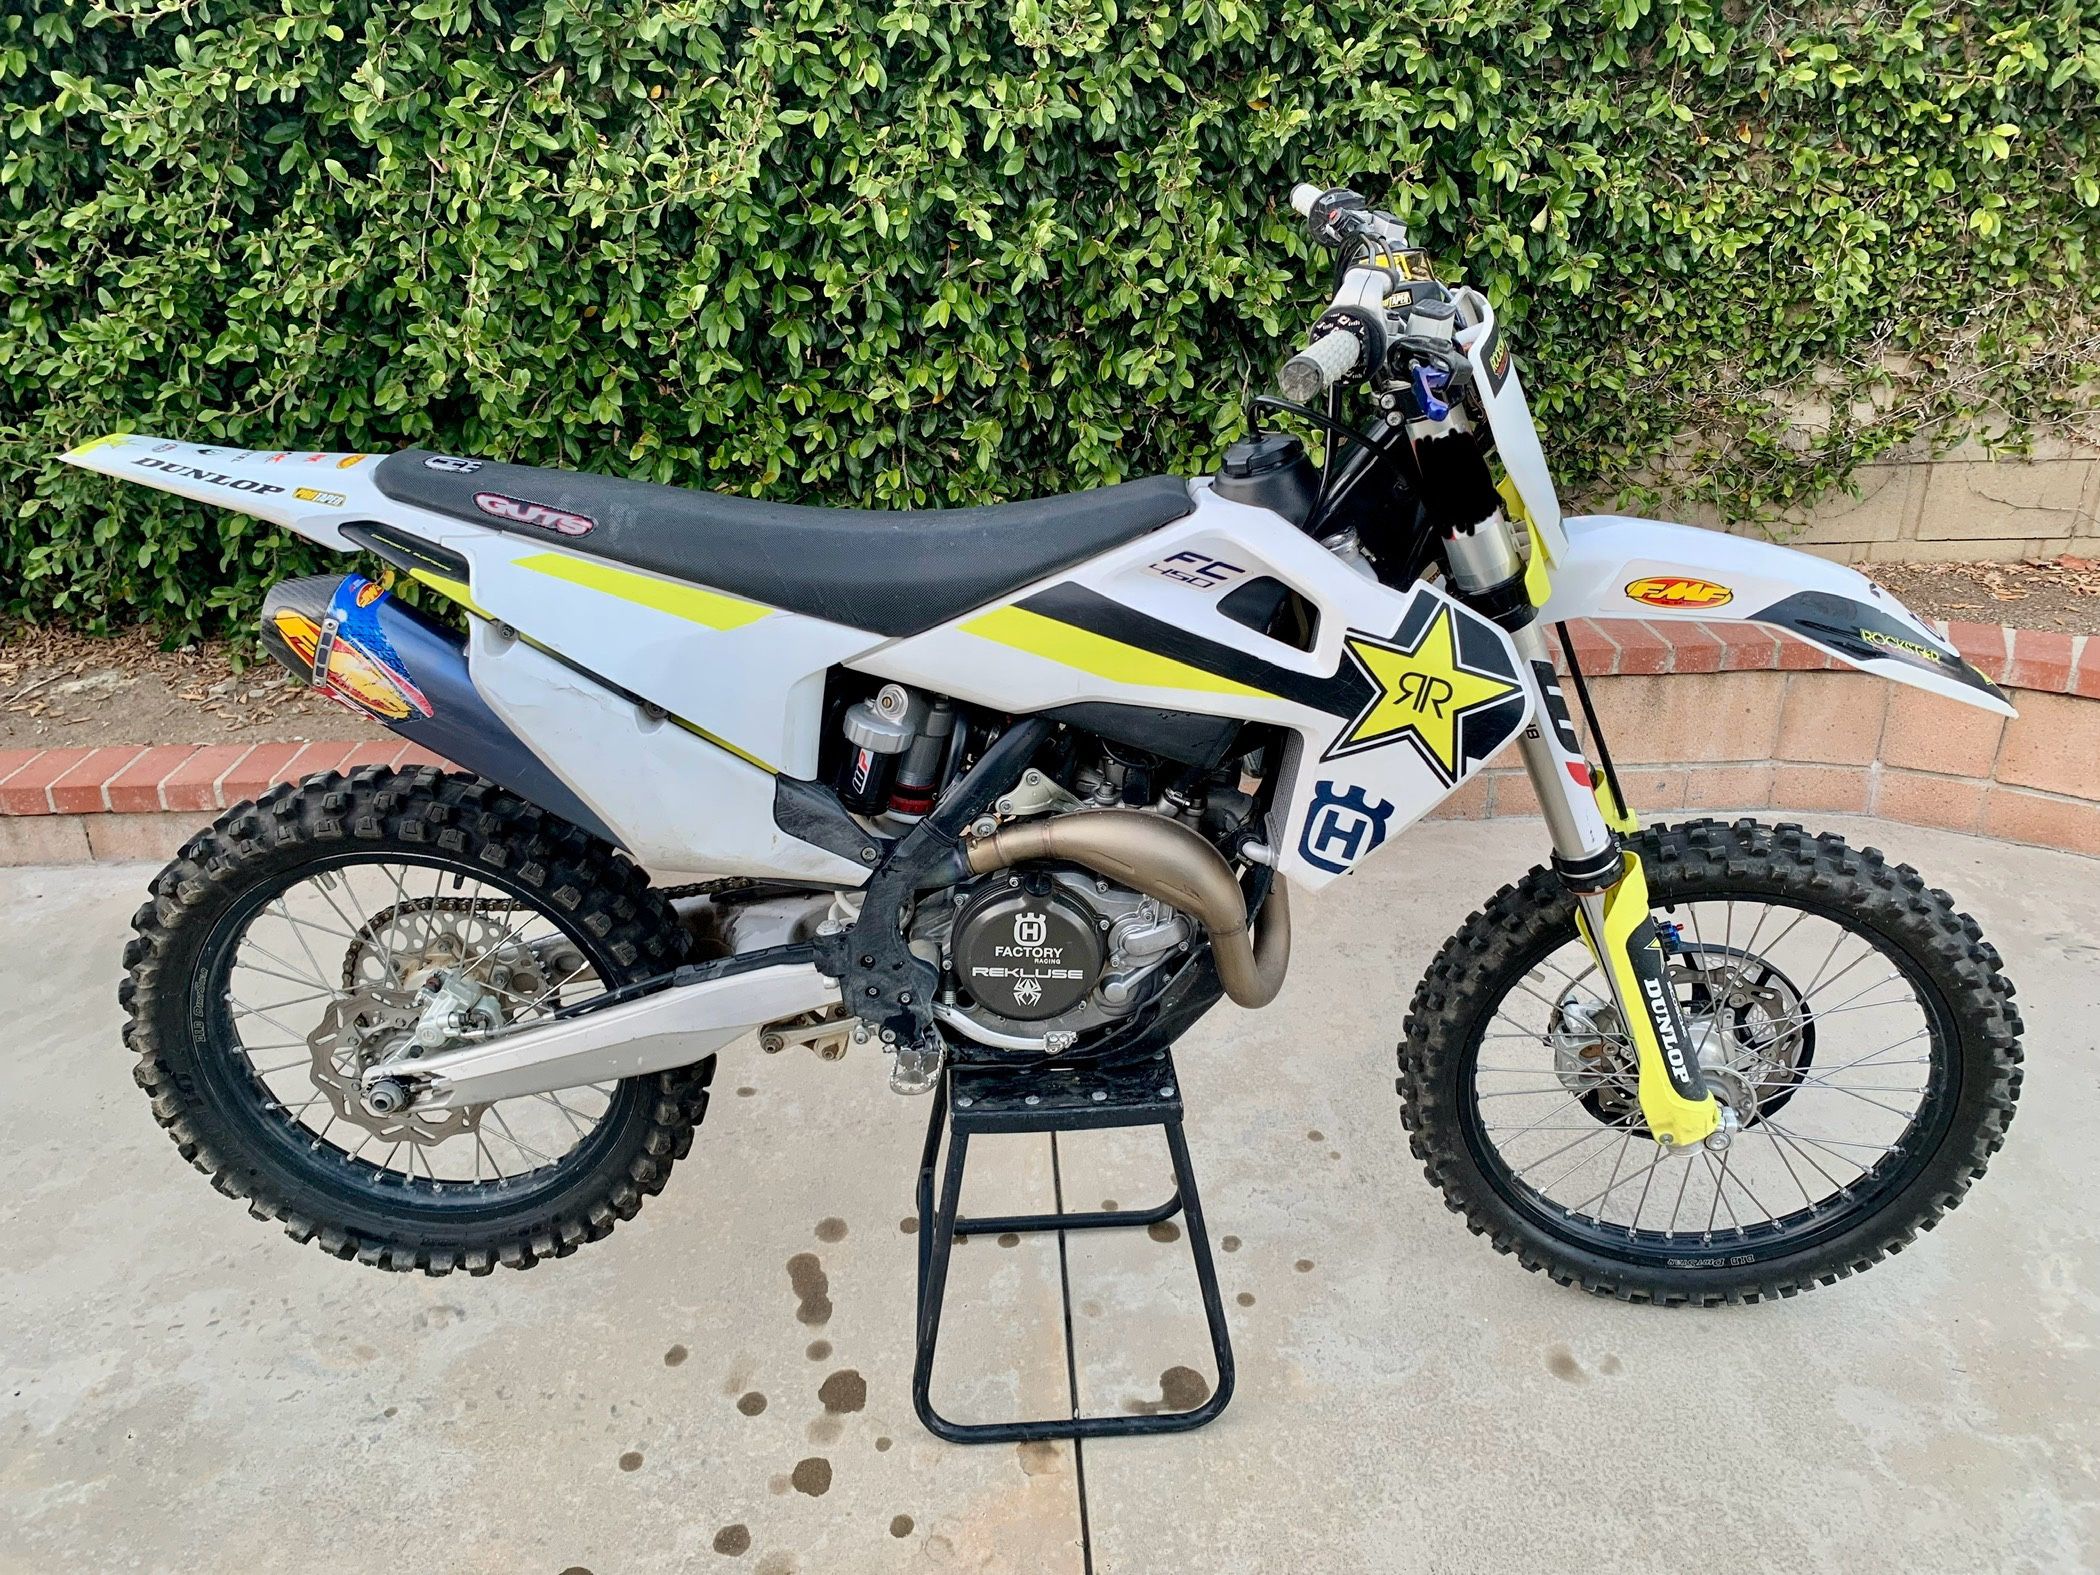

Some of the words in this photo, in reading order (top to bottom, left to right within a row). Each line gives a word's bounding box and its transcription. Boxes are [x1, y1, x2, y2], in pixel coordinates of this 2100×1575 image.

[131, 457, 286, 495] DUNLOP
[476, 494, 593, 536] GUTS
[1149, 564, 1216, 588] 450
[1163, 551, 1246, 580] FC
[1626, 581, 1733, 603] FMF
[994, 946, 1064, 959] FACTORY
[972, 966, 1084, 980] REKLUSE
[1643, 977, 1690, 1084] DUNLOP
